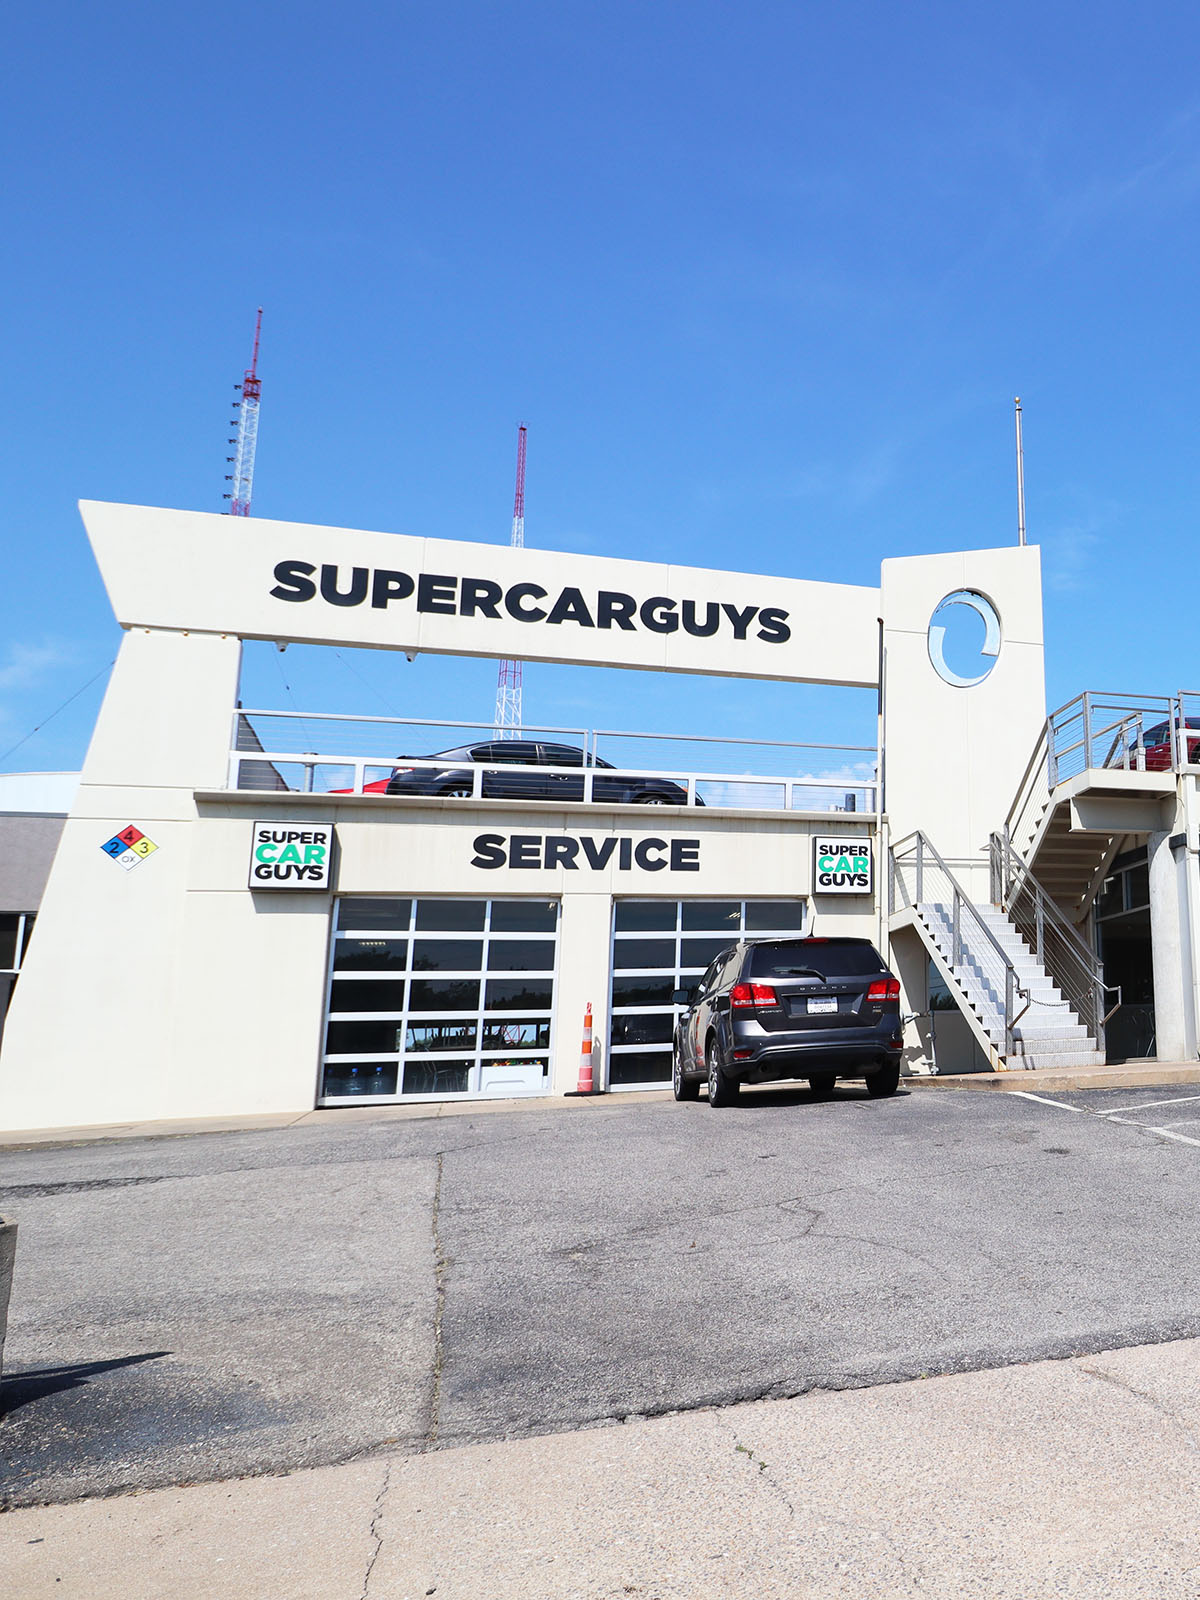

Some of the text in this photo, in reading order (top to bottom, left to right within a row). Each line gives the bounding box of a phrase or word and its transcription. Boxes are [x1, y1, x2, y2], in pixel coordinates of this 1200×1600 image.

[270, 560, 791, 645] SUPERCARGUYS
[123, 830, 134, 842] 4
[258, 830, 327, 844] SUPER
[109, 841, 120, 854] 2
[140, 841, 149, 854] 3
[255, 843, 326, 865] CAR
[471, 833, 699, 872] SERVICE
[819, 844, 869, 857] SUPER
[818, 855, 869, 873] CAR
[254, 863, 324, 881] GUYS
[818, 872, 869, 887] GUYS
